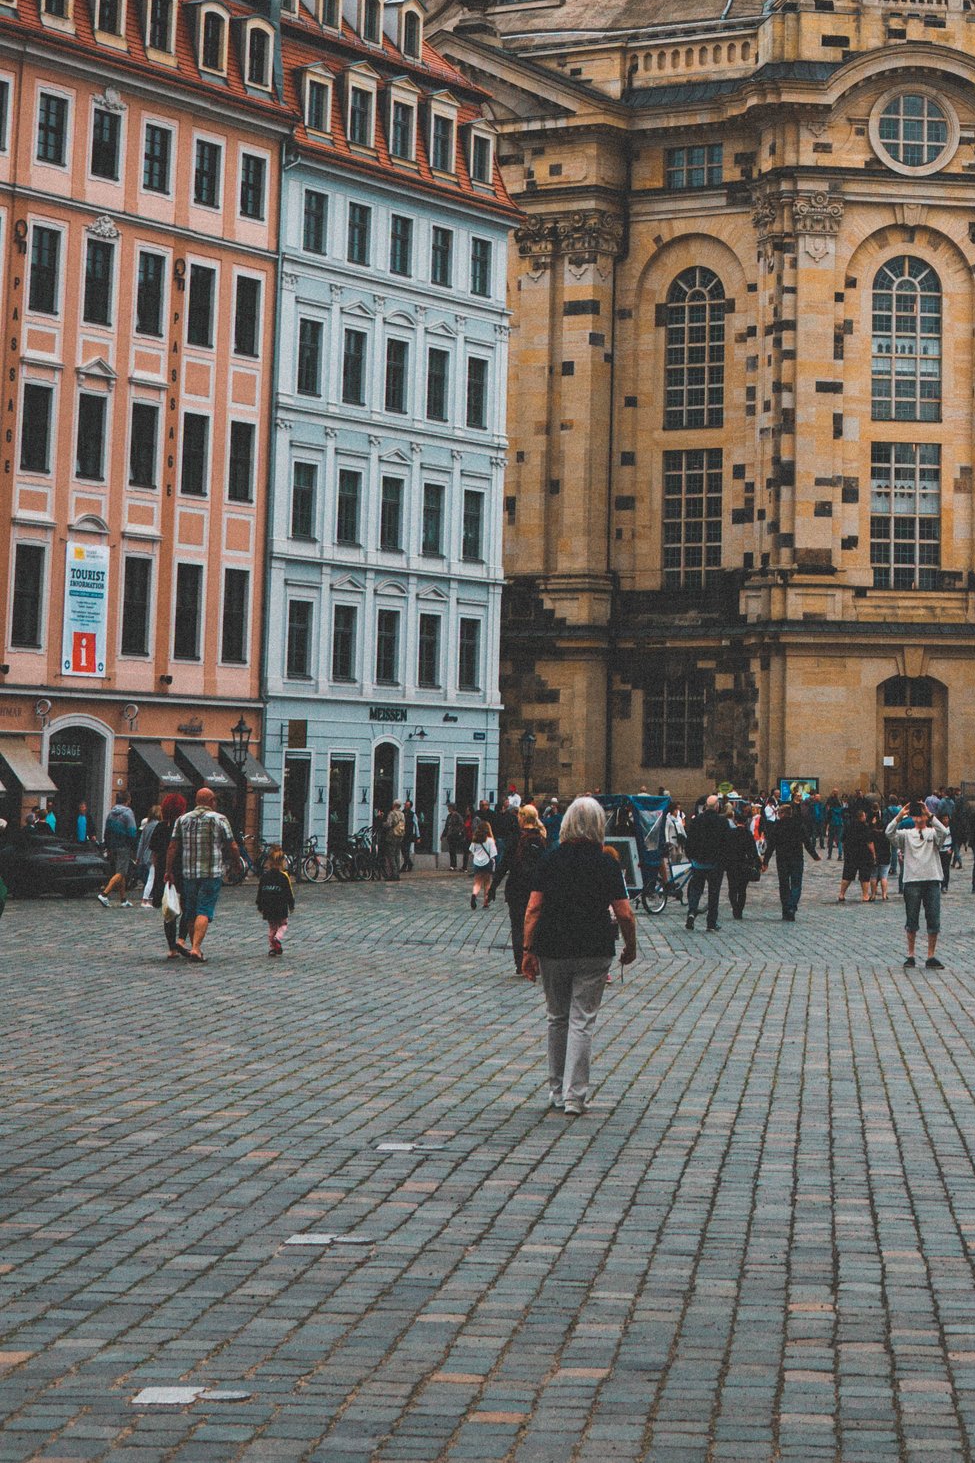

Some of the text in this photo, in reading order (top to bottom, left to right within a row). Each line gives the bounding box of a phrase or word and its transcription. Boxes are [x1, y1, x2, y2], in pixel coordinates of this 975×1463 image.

[4, 276, 21, 474] PASSAGE
[166, 312, 180, 497] PASSAGE
[71, 568, 105, 581] TOURIST
[70, 580, 104, 589] INFORMATION
[369, 706, 408, 723] MEISSEN
